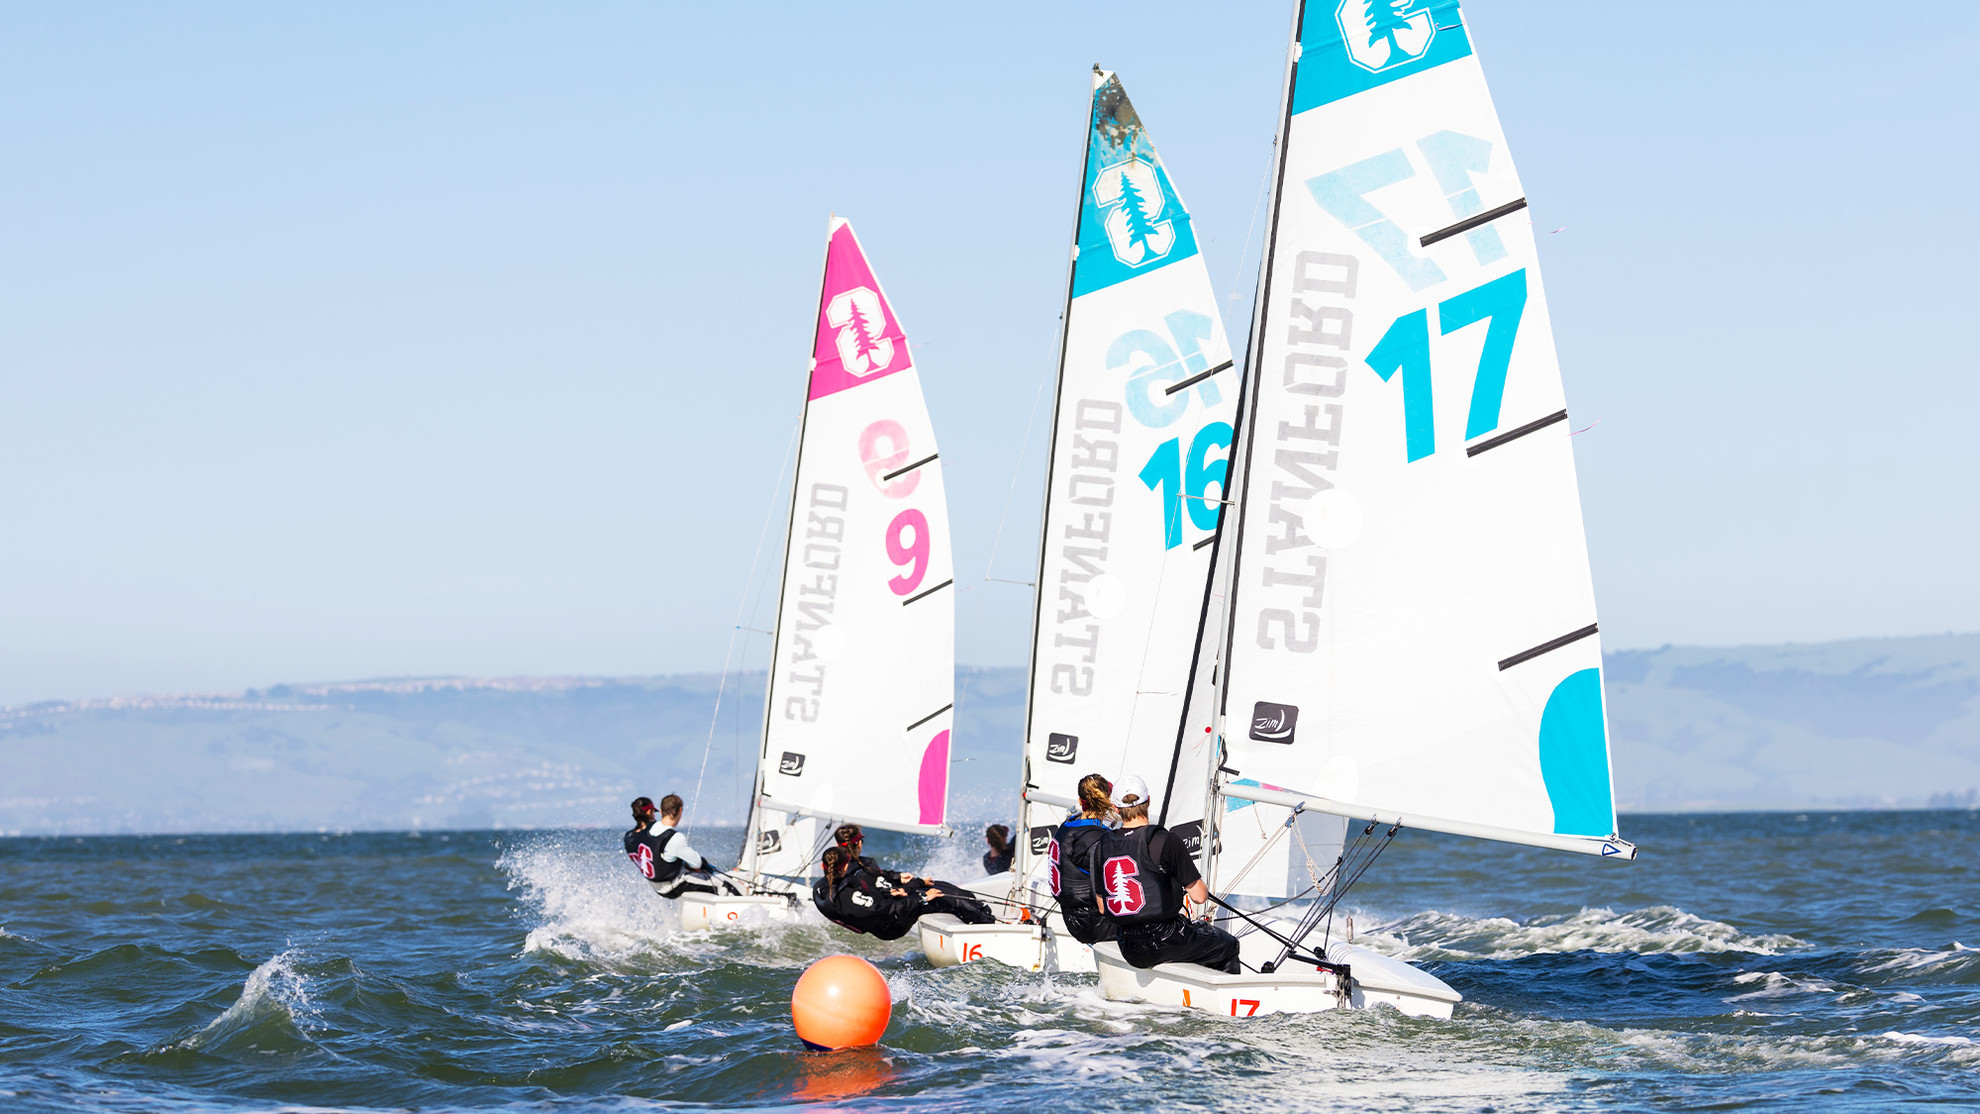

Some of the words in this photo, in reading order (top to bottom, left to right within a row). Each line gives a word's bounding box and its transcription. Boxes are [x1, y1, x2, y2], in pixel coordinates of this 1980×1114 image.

[1364, 267, 1528, 464] 17
[1138, 421, 1234, 551] 16
[885, 508, 930, 596] 9
[962, 942, 983, 962] 16
[1230, 998, 1260, 1017] 17
